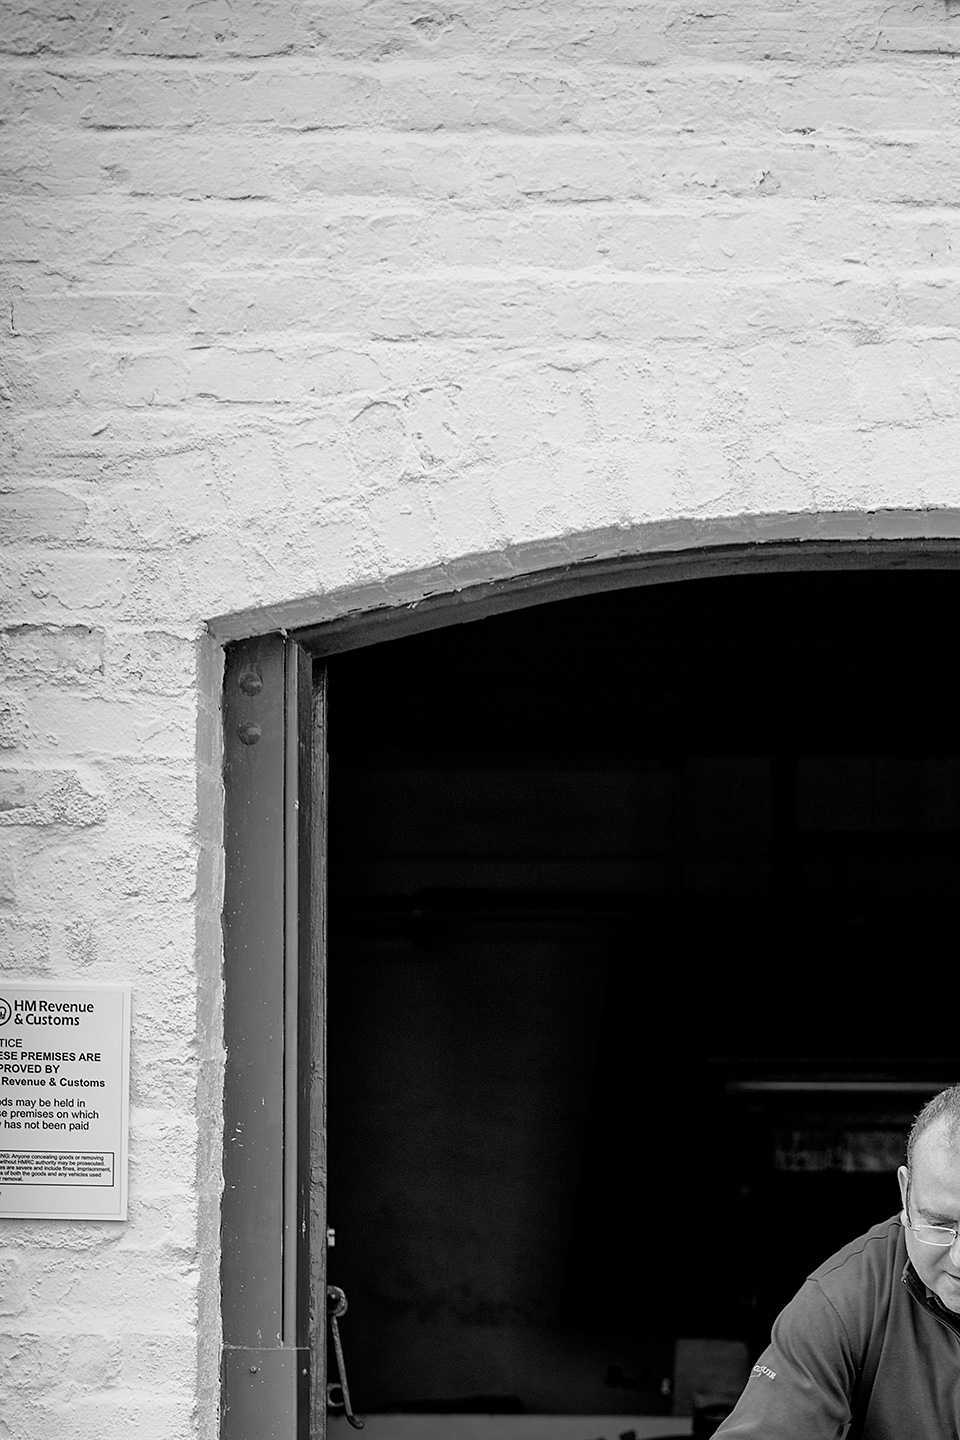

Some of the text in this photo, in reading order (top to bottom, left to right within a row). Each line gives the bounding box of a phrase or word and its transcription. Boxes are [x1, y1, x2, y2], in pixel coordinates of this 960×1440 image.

[14, 1000, 94, 1012] HM Revenue
[14, 1013, 80, 1026] & Customs
[21, 1052, 76, 1062] PREMISES
[79, 1053, 101, 1062] ARE
[45, 1065, 60, 1074] BY
[2, 1077, 105, 1087] Revenue & Customs
[16, 1100, 36, 1109] may
[39, 1098, 51, 1107] be
[54, 1098, 74, 1107] held
[77, 1098, 85, 1107] in
[10, 1109, 54, 1119] premises
[72, 1110, 99, 1119] which
[4, 1120, 21, 1129] has
[25, 1121, 40, 1129] not
[42, 1121, 66, 1129] been
[69, 1121, 89, 1132] paid
